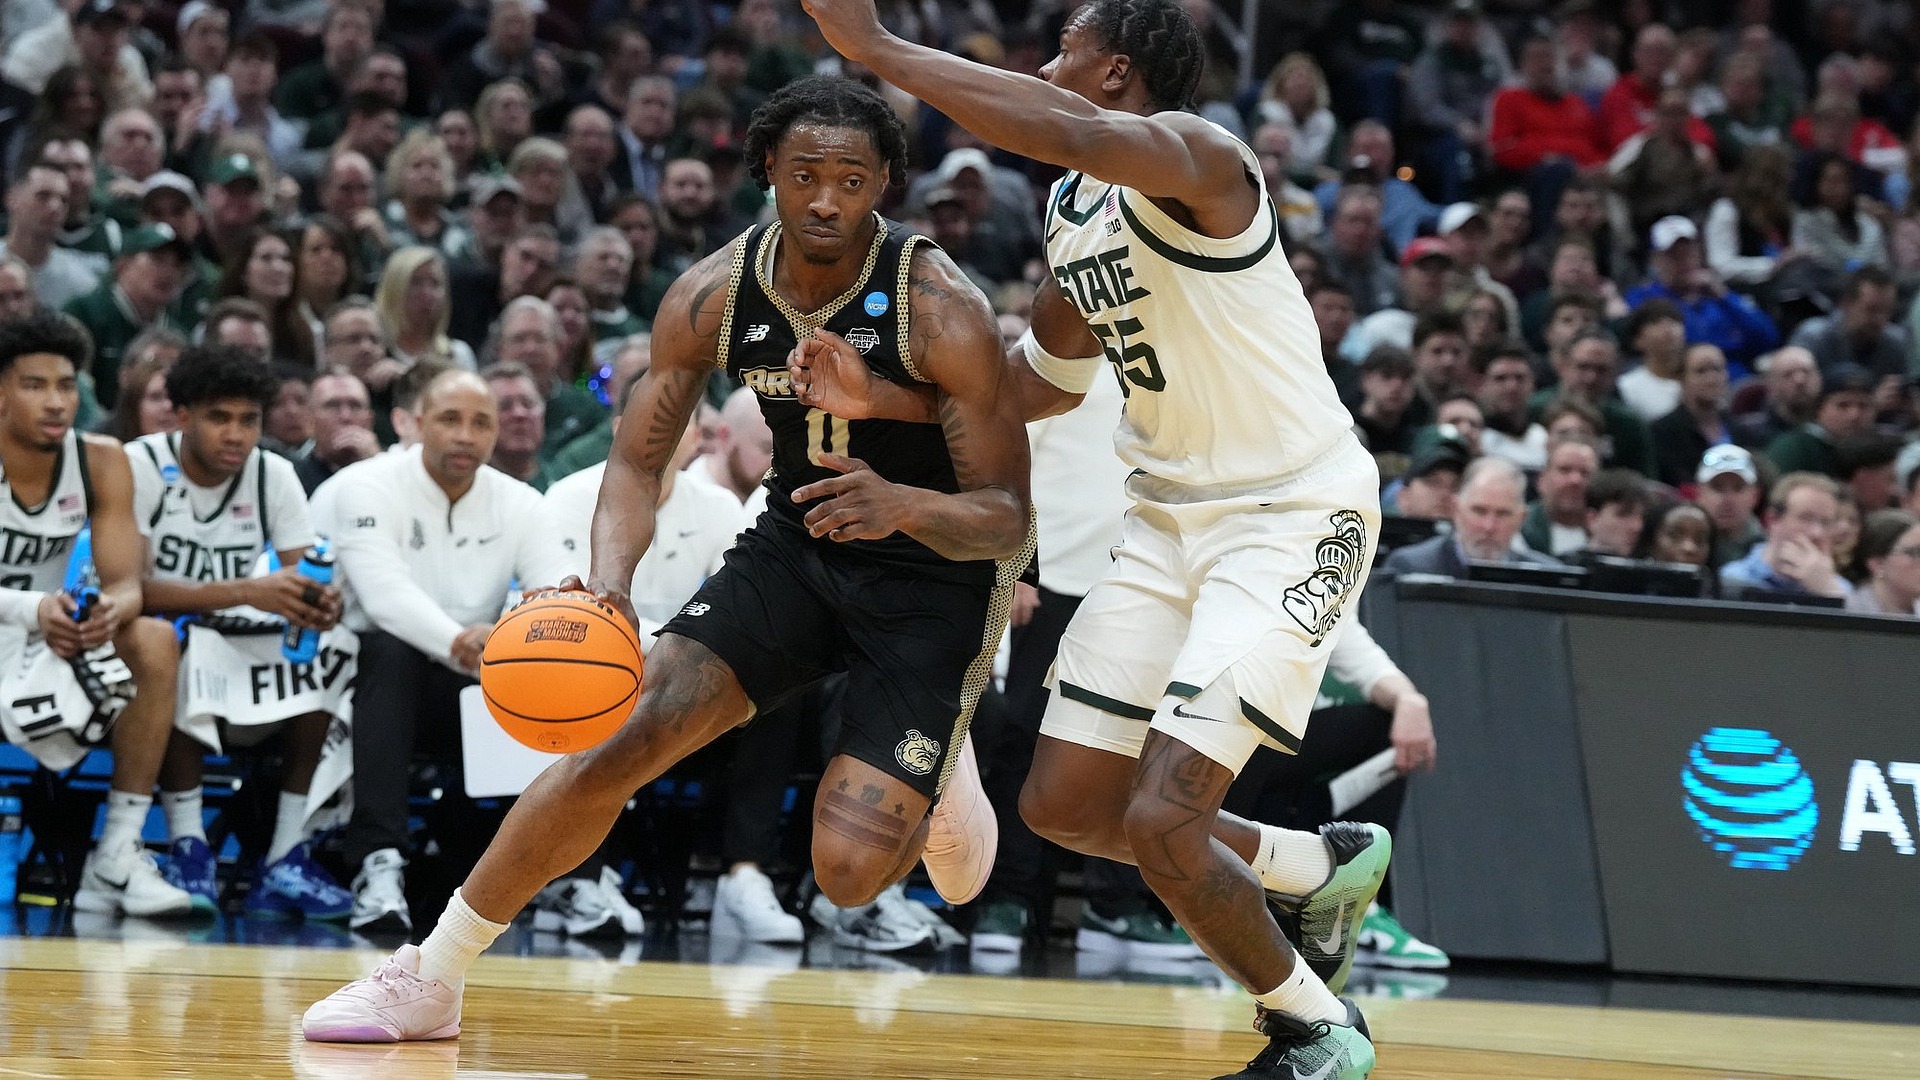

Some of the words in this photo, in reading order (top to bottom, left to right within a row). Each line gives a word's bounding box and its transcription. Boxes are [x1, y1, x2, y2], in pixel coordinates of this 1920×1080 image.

[1054, 245, 1151, 313] STATE
[846, 334, 879, 342] AMERICA
[1088, 317, 1166, 398] 55
[156, 534, 253, 581] STATE
[540, 620, 572, 631] MARCH
[542, 628, 586, 641] MADNESS
